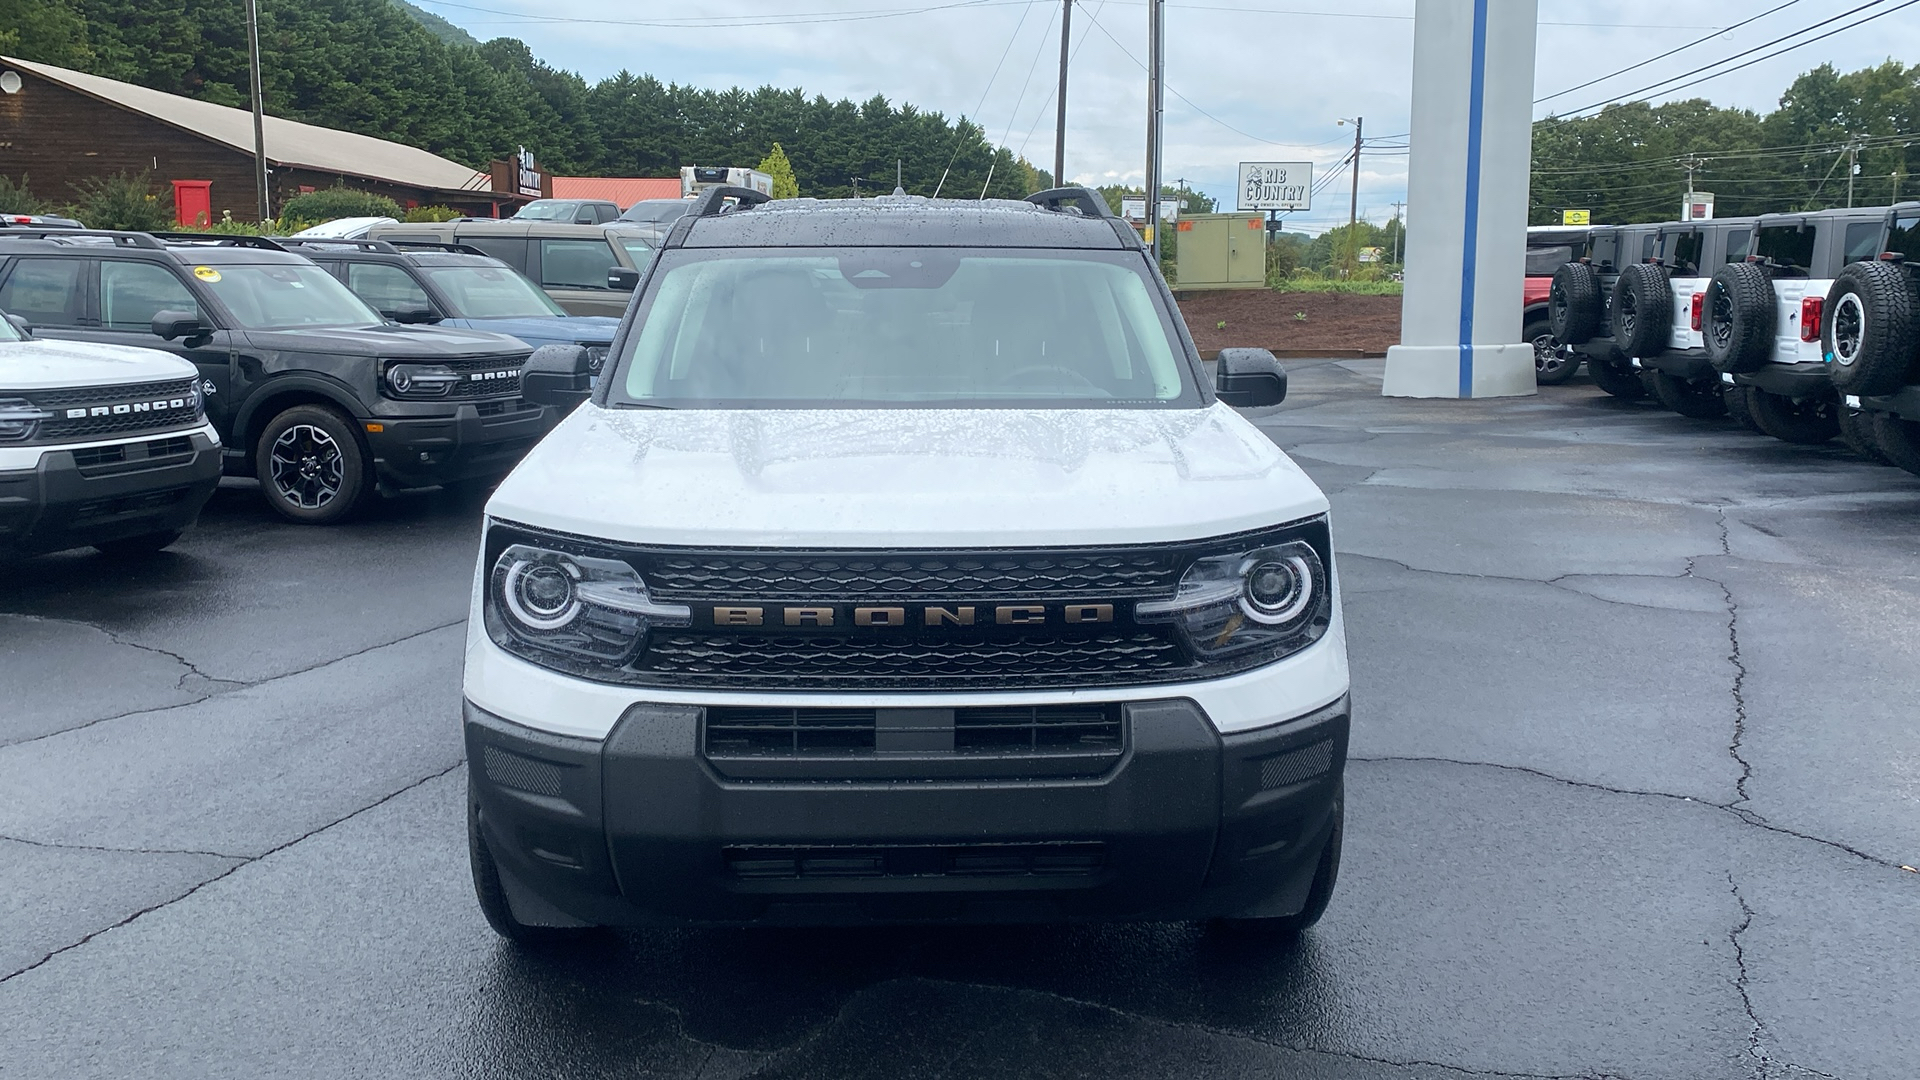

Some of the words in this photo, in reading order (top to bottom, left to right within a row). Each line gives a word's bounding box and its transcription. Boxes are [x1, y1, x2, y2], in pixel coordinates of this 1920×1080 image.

[1264, 168, 1287, 184] RIB
[1245, 185, 1304, 201] COUNTRY
[470, 369, 521, 381] BRON
[66, 398, 184, 419] BRONCO
[713, 603, 1114, 627] BRONCO
